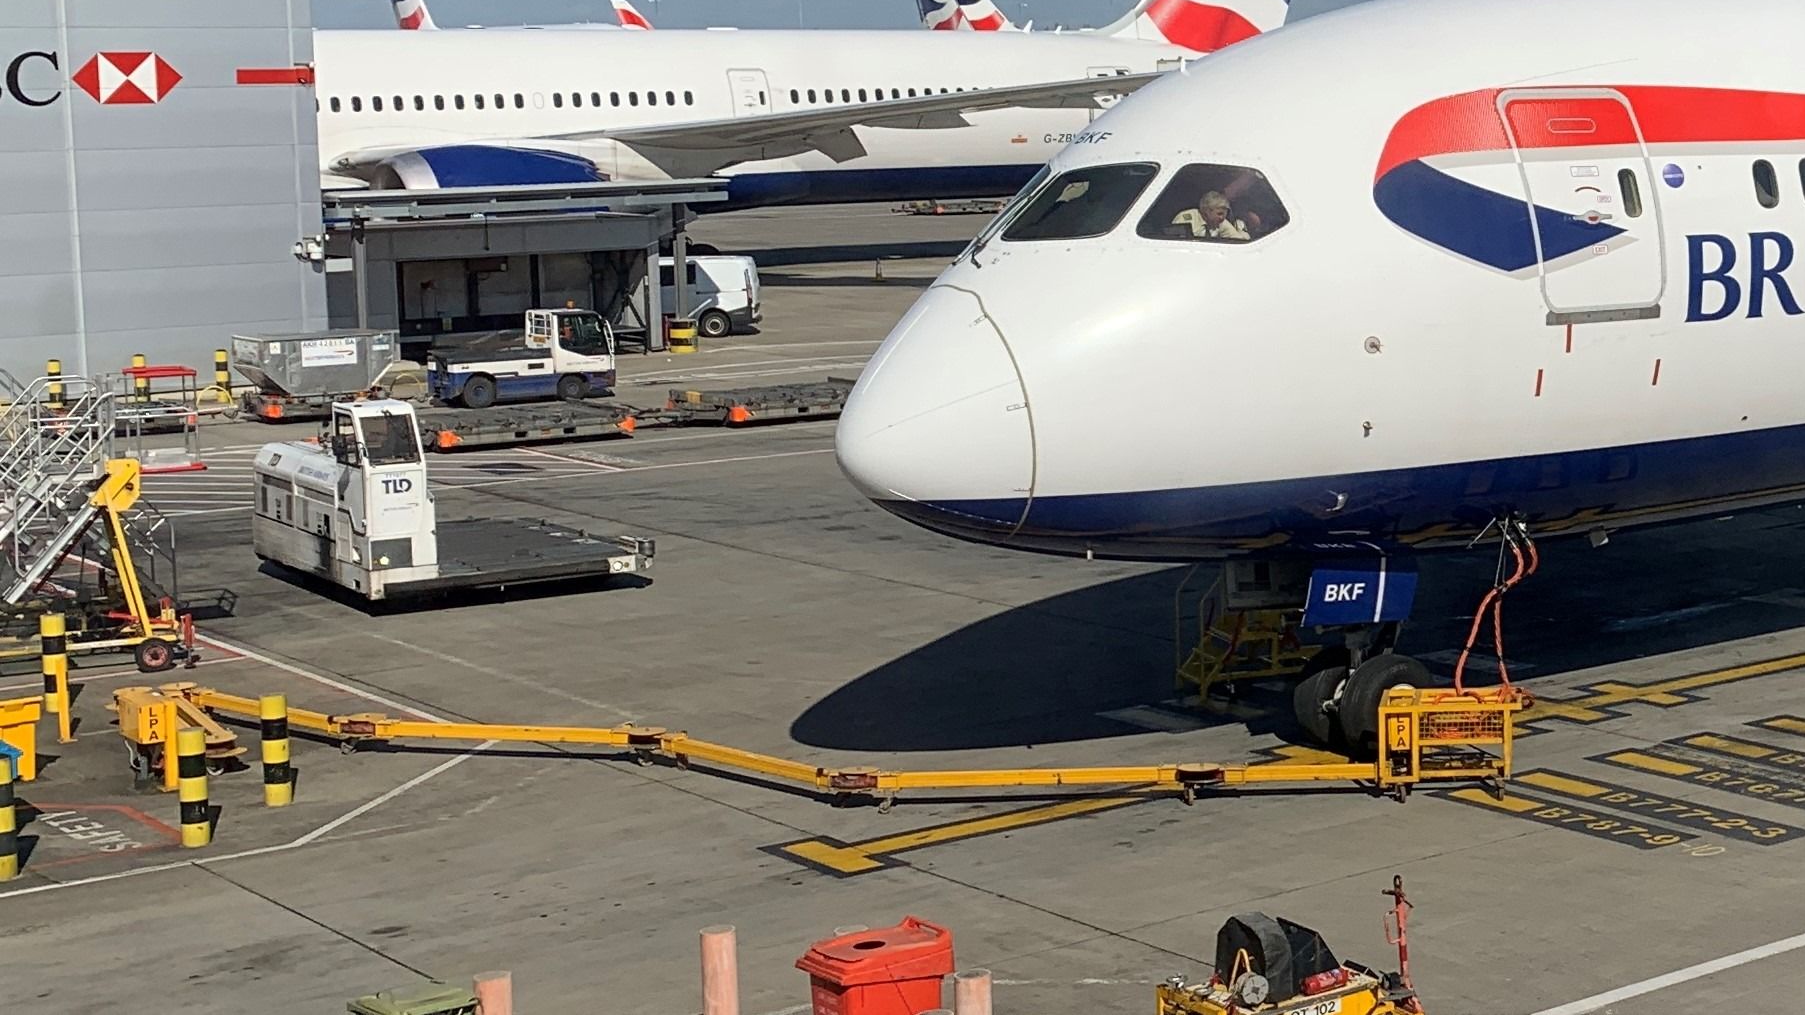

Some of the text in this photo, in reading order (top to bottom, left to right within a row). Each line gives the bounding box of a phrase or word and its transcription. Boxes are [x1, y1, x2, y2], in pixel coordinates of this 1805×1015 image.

[0, 51, 61, 106] C
[1043, 133, 1076, 144] G-ZB
[381, 478, 412, 494] TLD
[1324, 583, 1366, 602] BKF
[149, 707, 159, 741] LPA
[1396, 715, 1406, 748] LPA
[1601, 792, 1787, 839] B777-2-3
